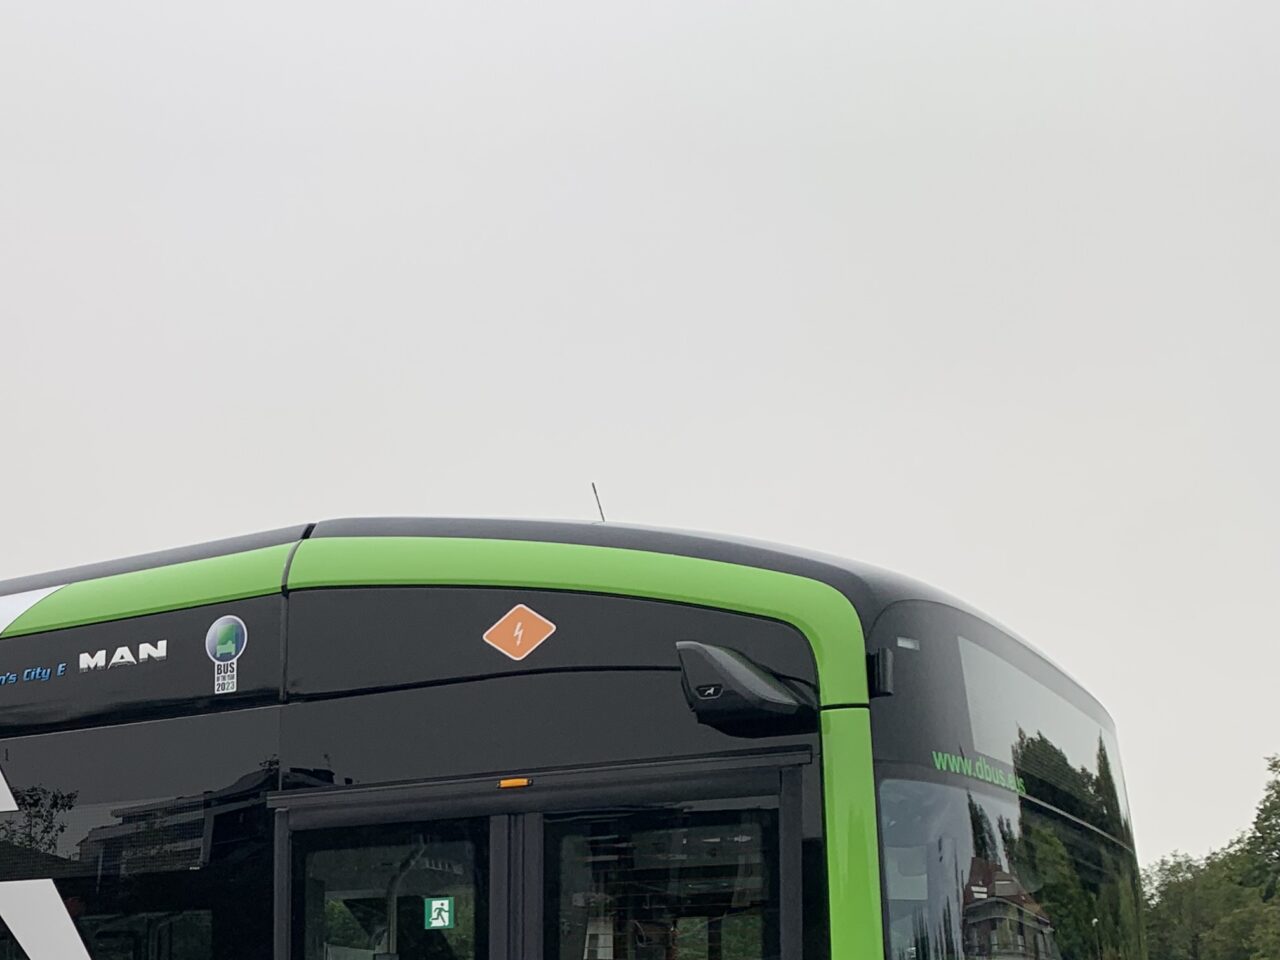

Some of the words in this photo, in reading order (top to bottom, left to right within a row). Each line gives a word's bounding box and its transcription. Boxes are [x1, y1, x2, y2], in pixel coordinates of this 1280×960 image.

[79, 640, 167, 672] MAN
[23, 666, 51, 683] City
[56, 663, 67, 677] E
[216, 662, 235, 674] BUS
[216, 681, 235, 692] 2023
[932, 751, 1026, 795] www.dbus.eus
